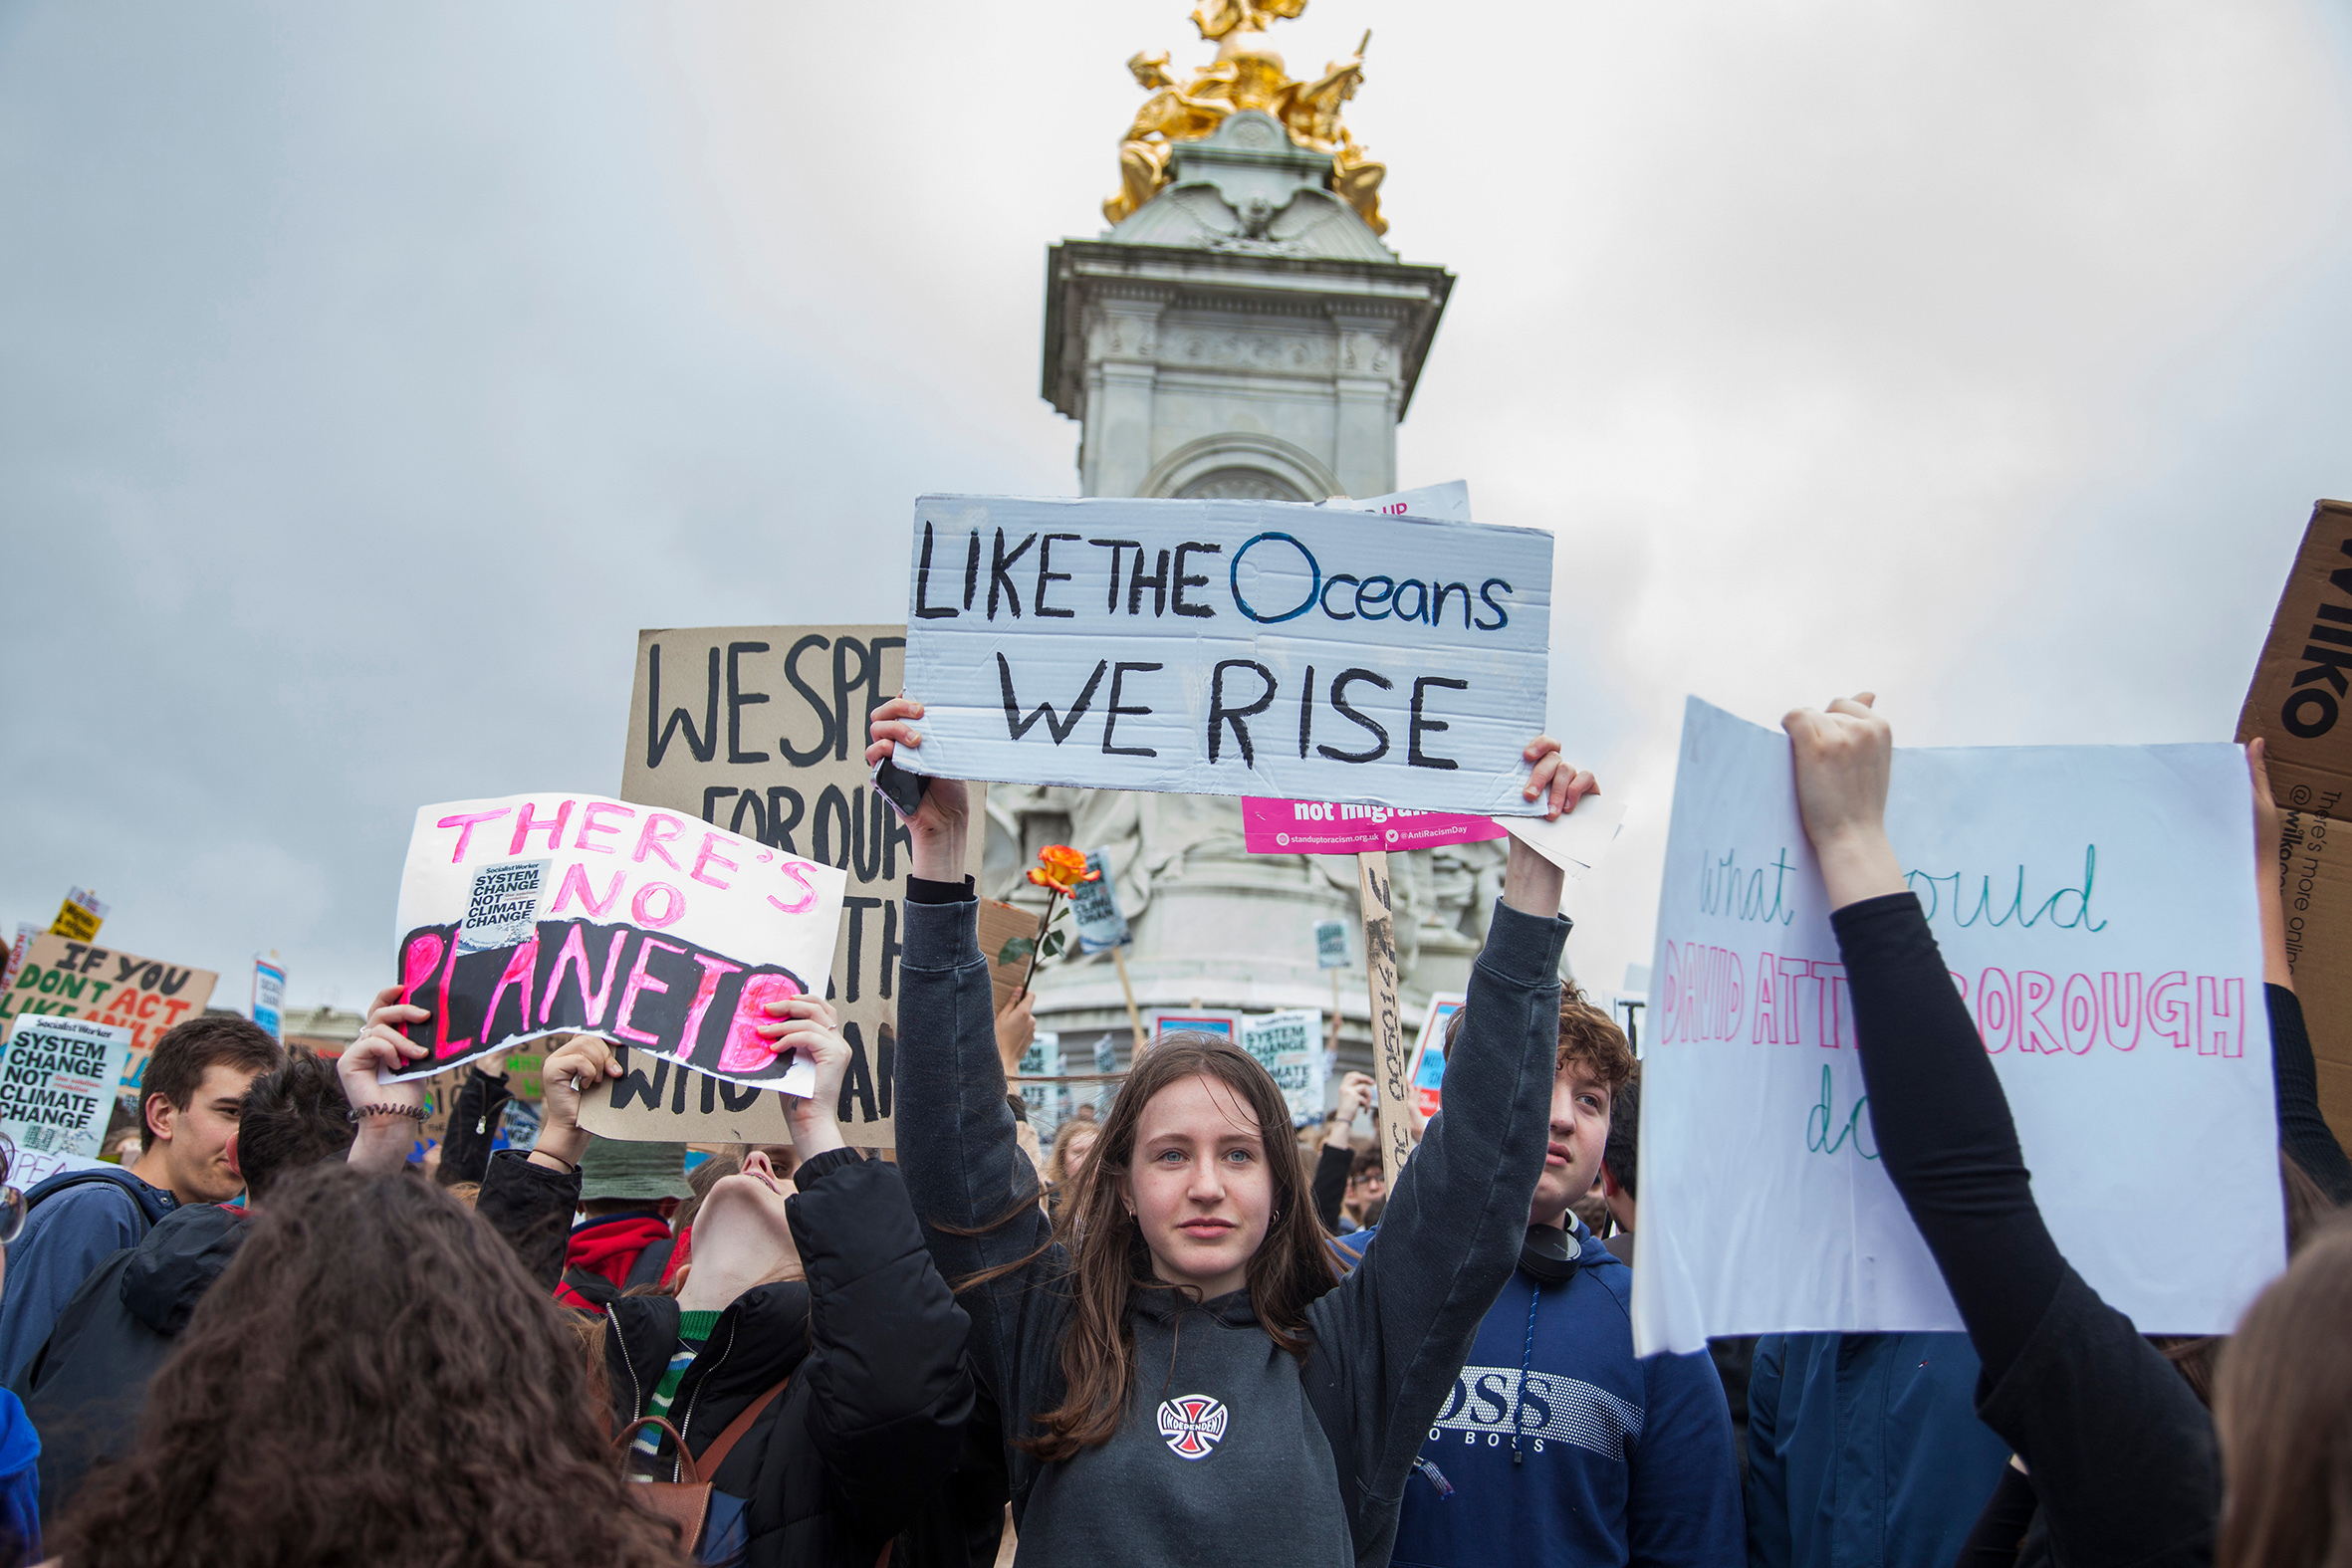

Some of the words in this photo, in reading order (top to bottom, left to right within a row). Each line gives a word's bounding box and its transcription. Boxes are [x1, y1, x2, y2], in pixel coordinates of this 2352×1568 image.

[914, 521, 1082, 622] LIKE
[1087, 538, 1223, 618] THE
[1230, 531, 1514, 631] Oceans
[646, 641, 771, 769] WE
[780, 634, 907, 768] SPE
[996, 651, 1164, 758] WE
[1207, 659, 1469, 770] RISE
[1294, 802, 1335, 821] not
[1291, 833, 1379, 844] standuptoracism.org.uk
[1400, 825, 1468, 839] @AntiRacismDay
[437, 799, 819, 915] THERE'S
[486, 865, 514, 874] Socialist
[473, 879, 540, 896] CHANGE
[475, 869, 539, 886] SYSTEM
[1903, 844, 2107, 933] ould
[2294, 857, 2319, 911] more
[468, 899, 537, 918] CLIMATE
[471, 893, 503, 907] NOT
[551, 863, 688, 929] NO
[466, 910, 533, 929] CHANGE
[56, 943, 109, 974] IF
[114, 955, 192, 997] YOU
[15, 963, 113, 1004] DON'T
[107, 987, 193, 1026] ACT
[399, 923, 744, 1066] PLANET
[717, 973, 802, 1074] B
[1662, 939, 1745, 1044] DAVID
[1753, 951, 2243, 1058] ATTOROUGH
[13, 1031, 108, 1060] SYSTEM
[1247, 1025, 1305, 1042] SYSTEM
[1247, 1037, 1308, 1055] CHANGE
[4, 1065, 53, 1087] NOT
[9, 1048, 108, 1079] CHANGE
[0, 1084, 100, 1114] CLIMATE
[1162, 1409, 1223, 1435] INDEPENDENT
